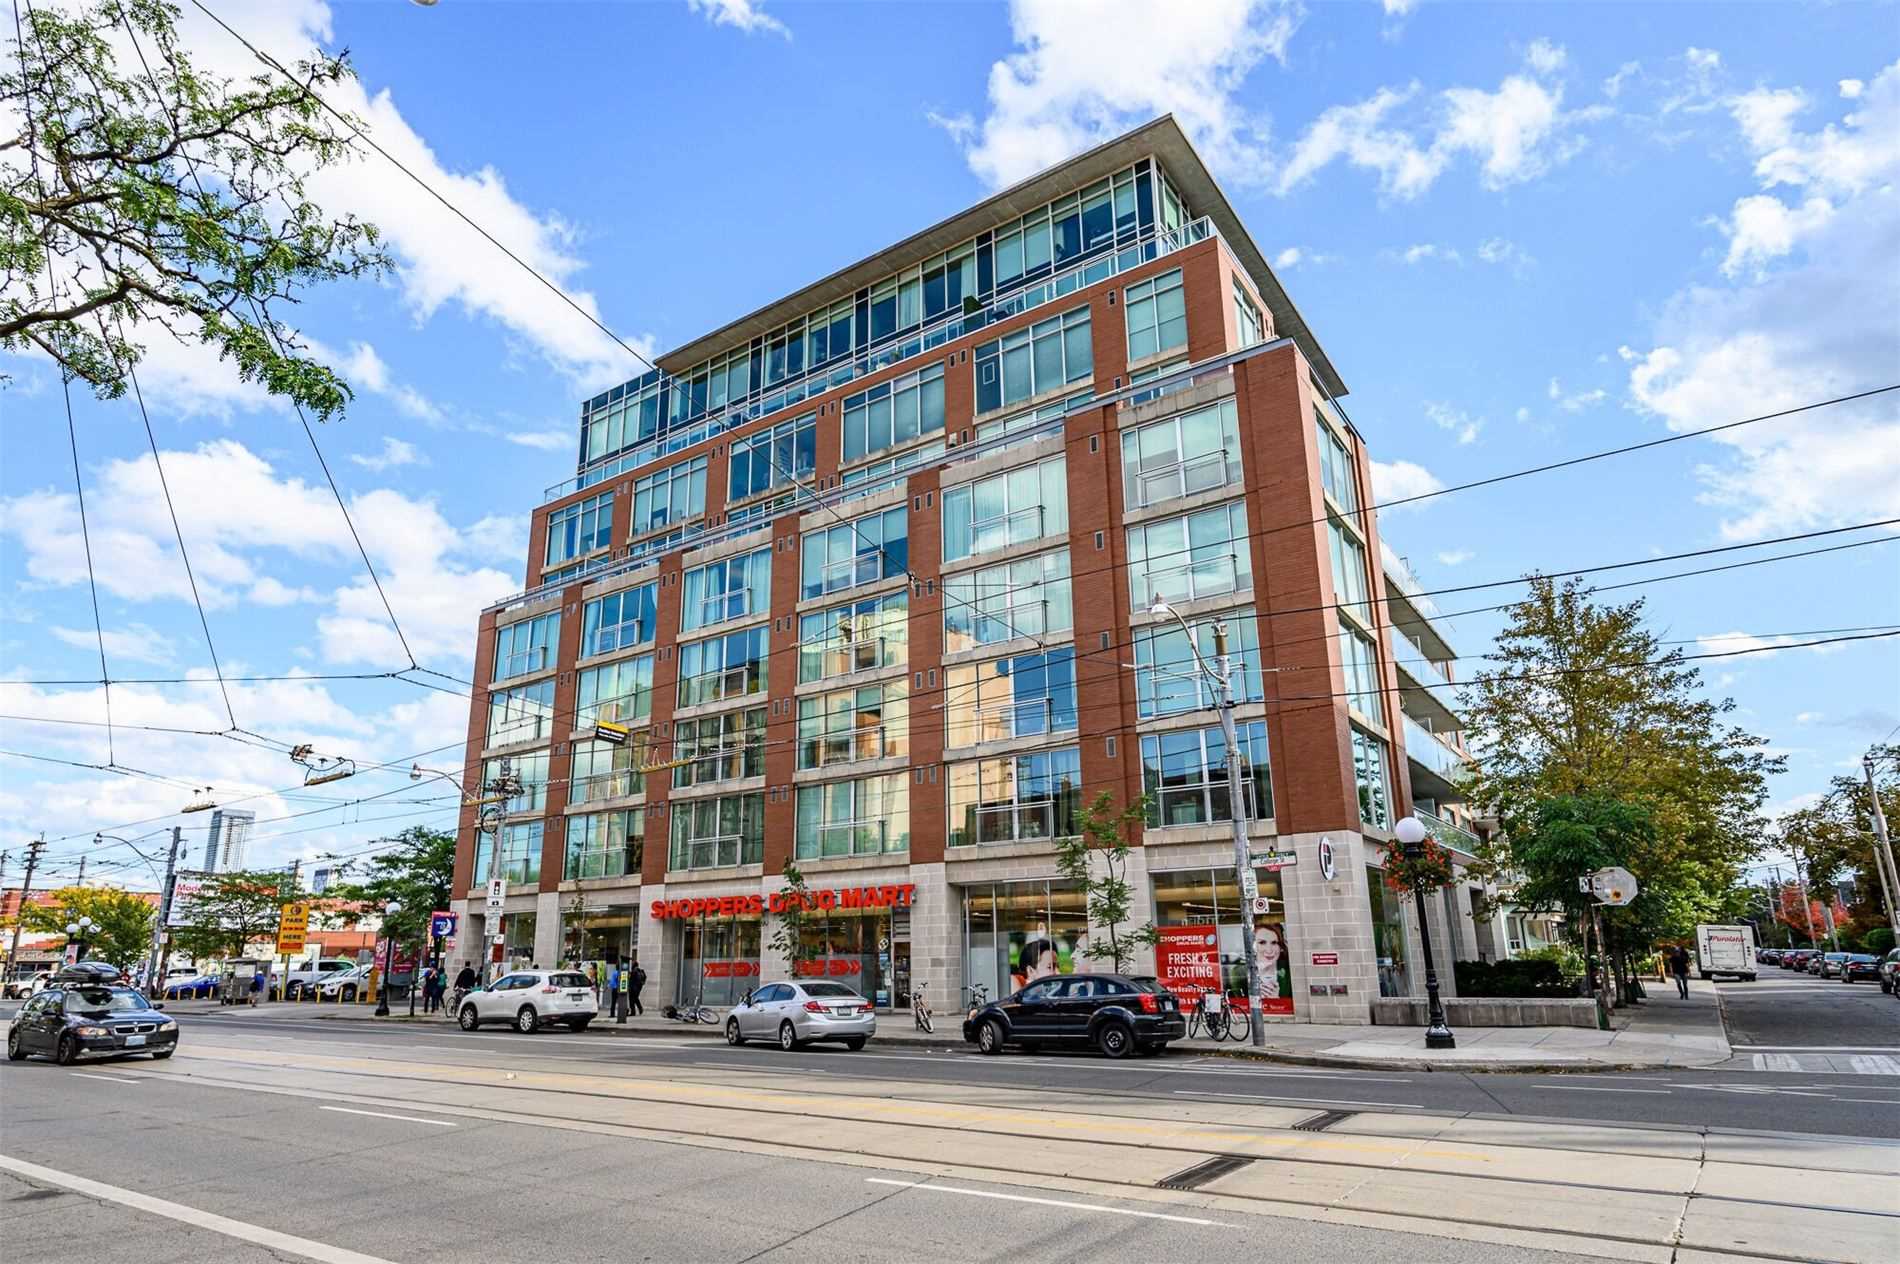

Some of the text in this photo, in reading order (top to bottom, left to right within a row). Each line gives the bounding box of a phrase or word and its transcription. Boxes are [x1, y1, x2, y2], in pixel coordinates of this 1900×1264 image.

[651, 894, 763, 920] SHOPPERS
[840, 883, 915, 909] MART
[1168, 952, 1209, 965] FRESH &
[1167, 966, 1213, 978] EXCITING
